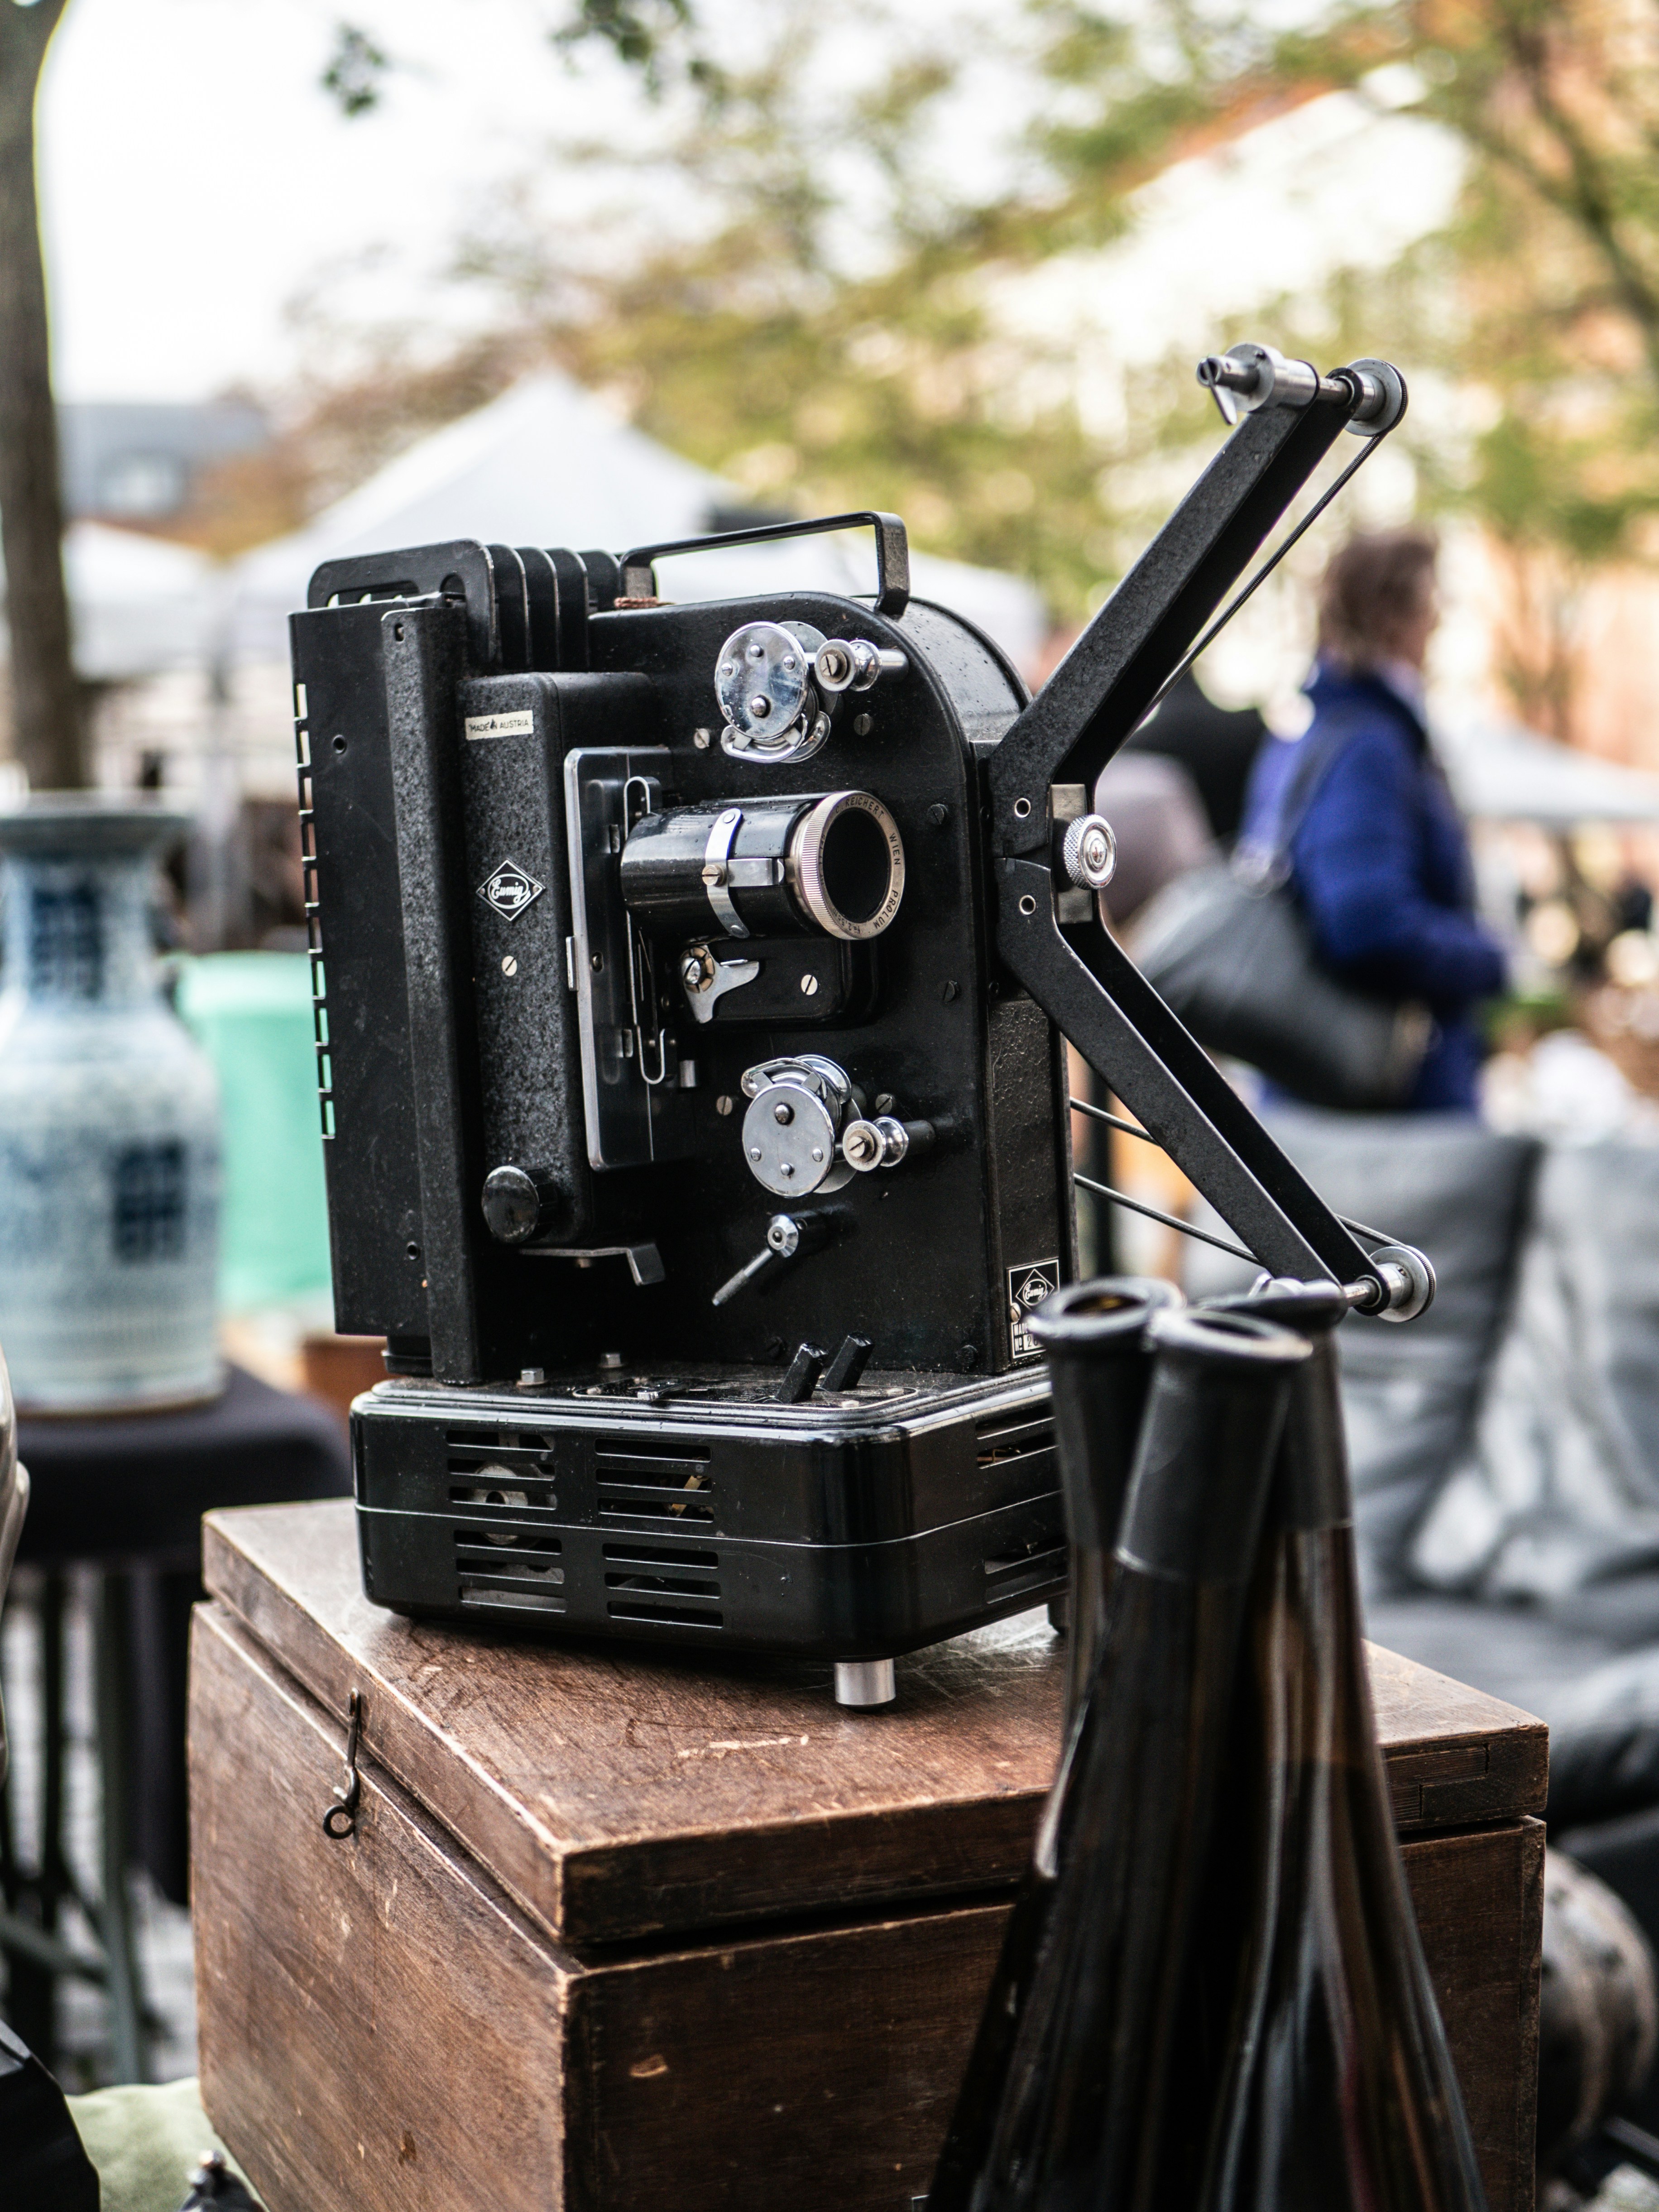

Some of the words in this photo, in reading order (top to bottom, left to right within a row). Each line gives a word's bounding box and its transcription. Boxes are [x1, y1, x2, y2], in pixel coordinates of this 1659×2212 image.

[469, 722, 490, 732] MADE
[500, 720, 529, 729] AUSTRIA
[845, 797, 884, 819] REICHERT
[889, 833, 901, 865] WIEN
[490, 877, 527, 906] Eumig
[873, 890, 898, 930] PROLUM
[1024, 1281, 1046, 1303] Eumig
[1014, 1323, 1028, 1336] MADE
